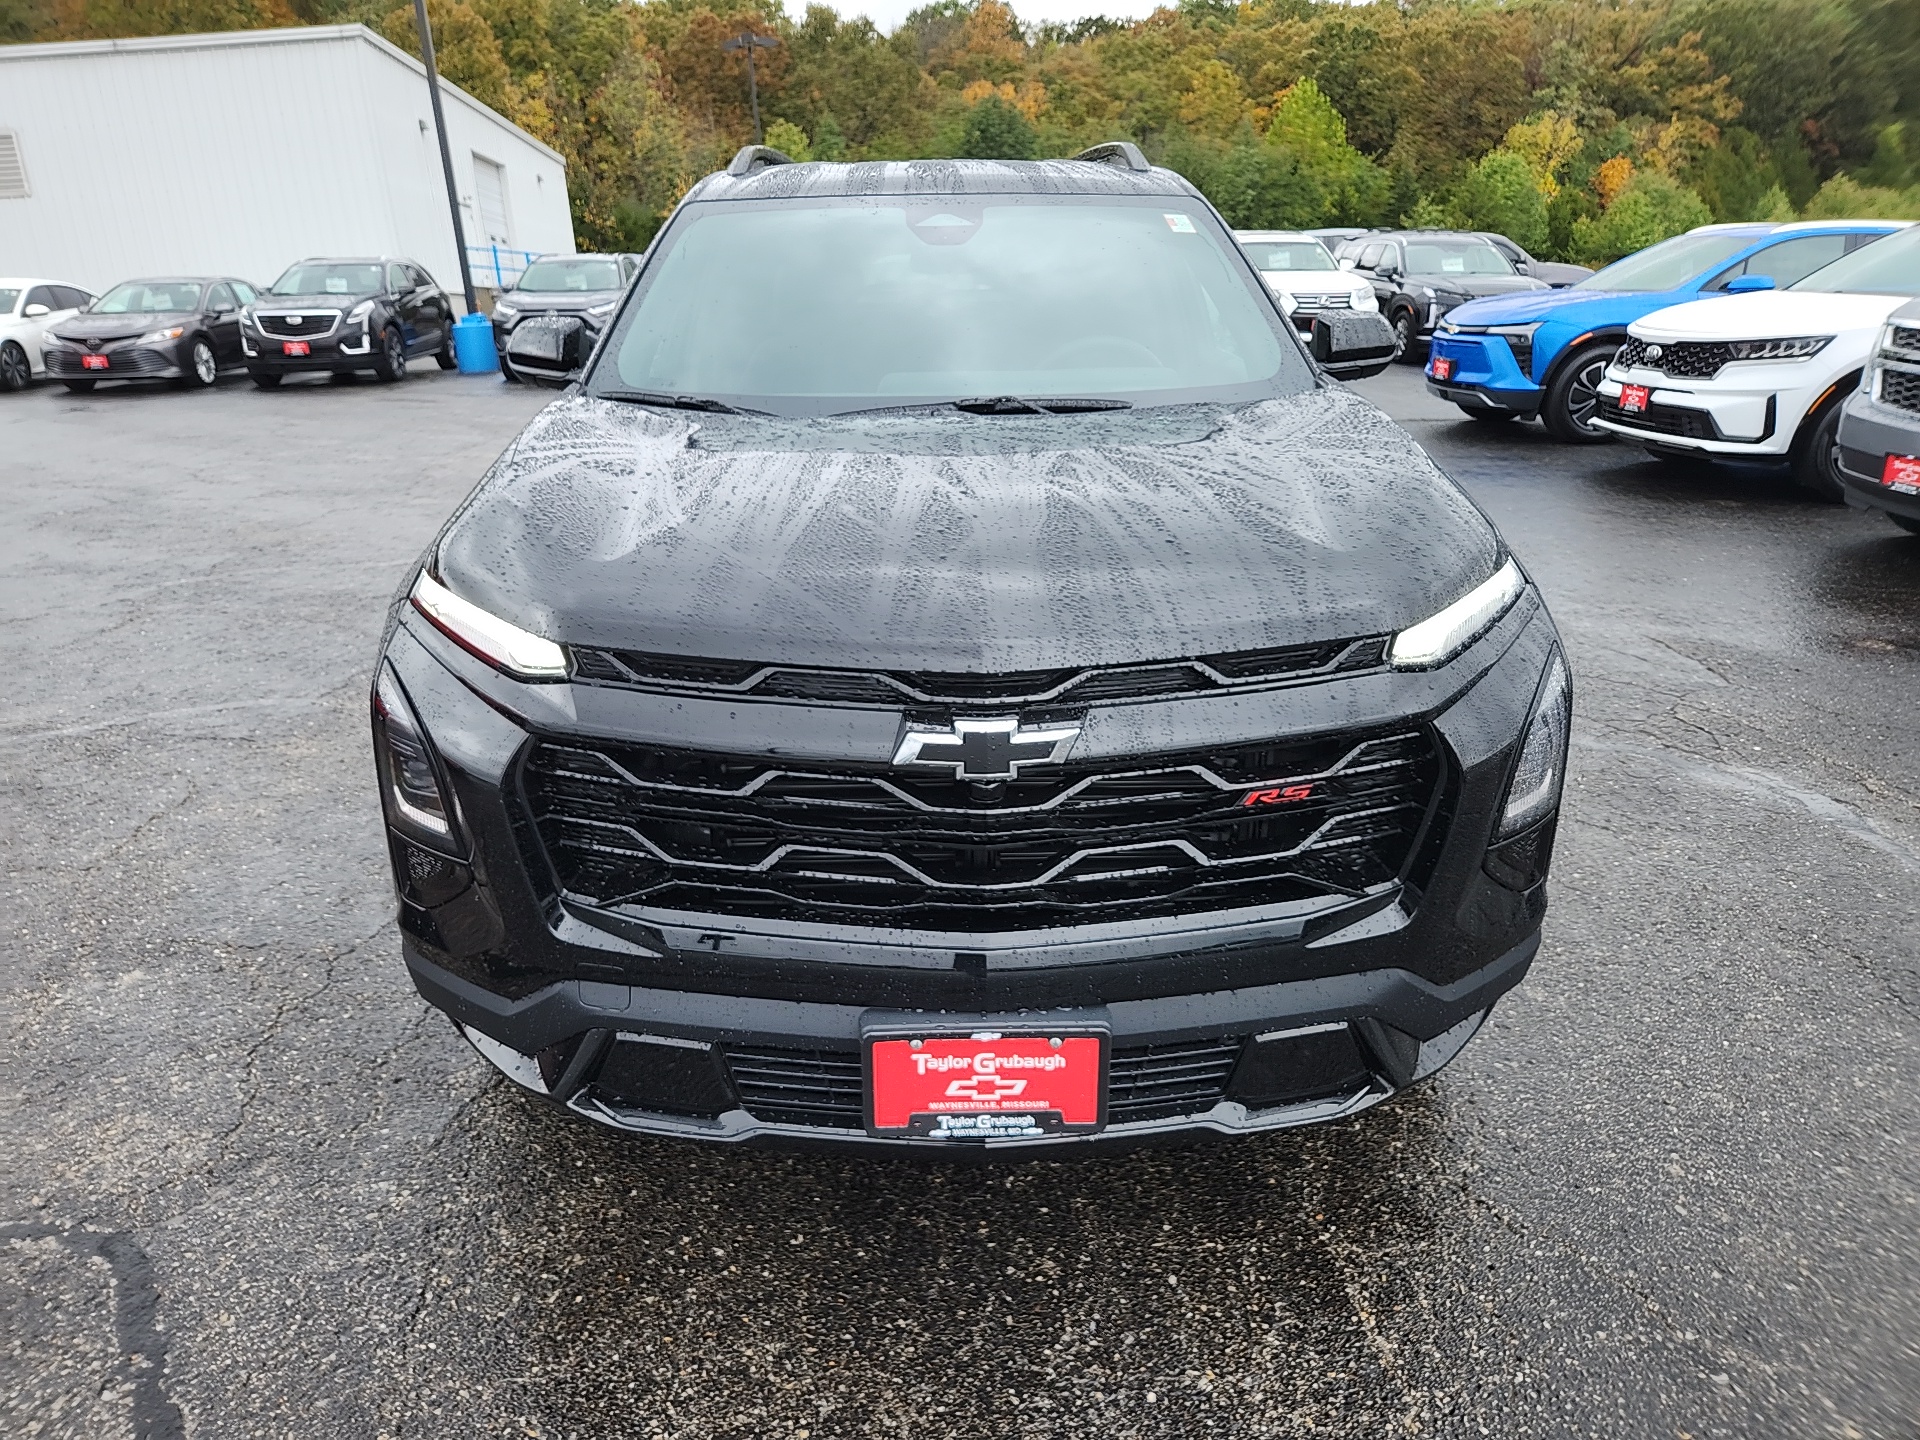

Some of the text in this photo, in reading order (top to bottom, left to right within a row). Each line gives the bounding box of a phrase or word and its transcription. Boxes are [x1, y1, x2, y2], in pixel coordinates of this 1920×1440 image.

[1243, 783, 1314, 806] RS
[911, 1052, 1067, 1075] Taylor Grubaugh
[928, 1100, 1050, 1110] WAYNESVILLE, MISSOURI
[936, 1114, 1036, 1130] Taylor Grubaugh
